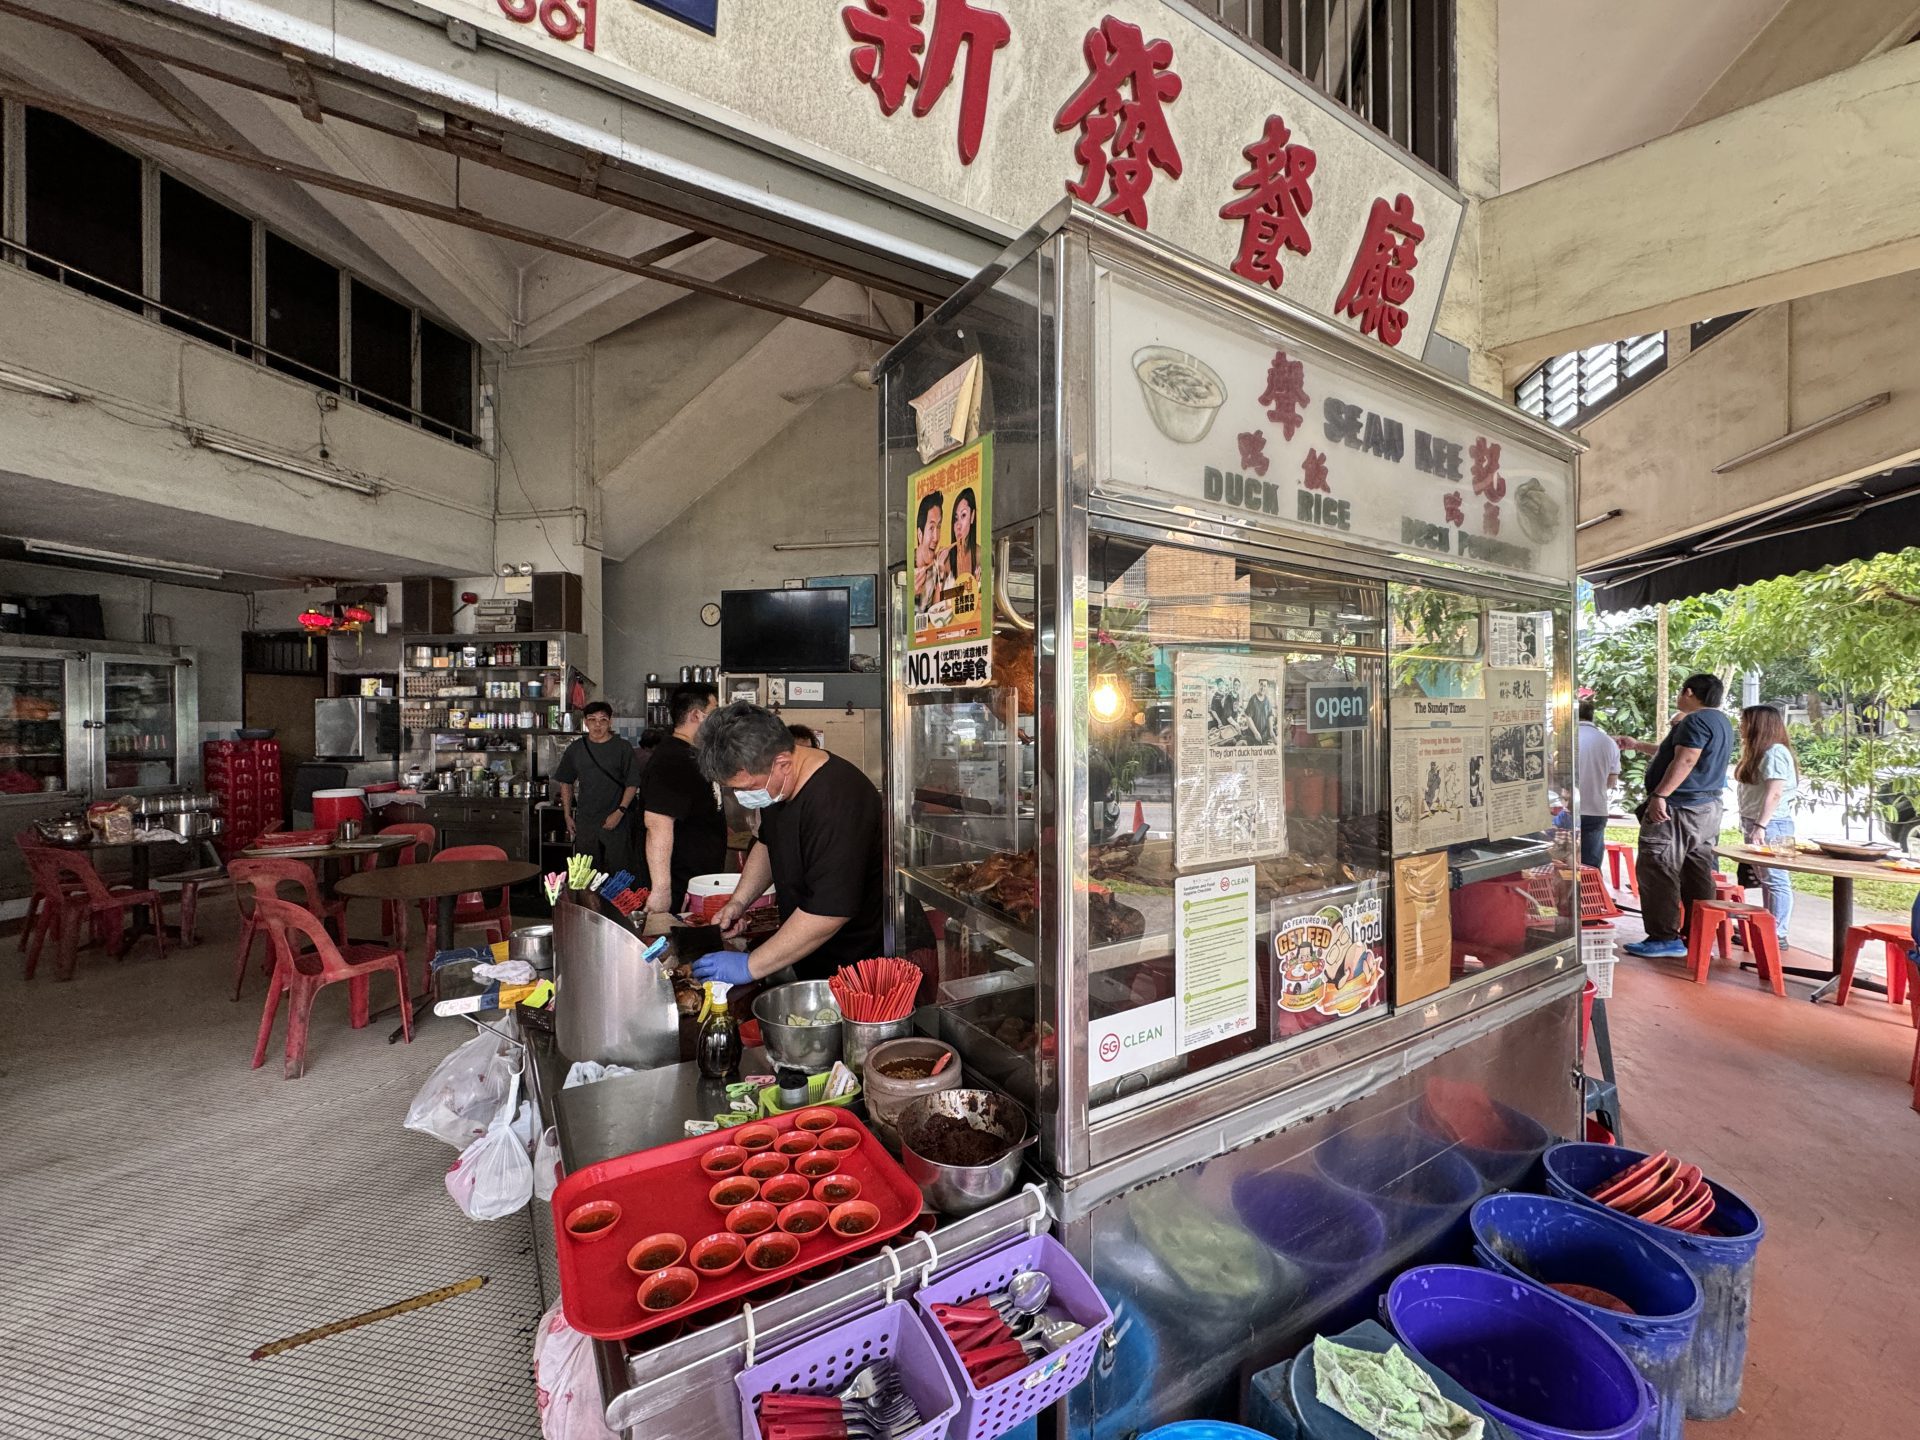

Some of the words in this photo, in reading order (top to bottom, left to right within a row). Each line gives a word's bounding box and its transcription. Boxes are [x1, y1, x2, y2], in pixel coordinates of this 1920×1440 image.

[1323, 397, 1405, 464] SEAN
[1415, 429, 1464, 482] KEE
[1203, 465, 1280, 517] DUCK
[1297, 488, 1351, 531] RICE
[908, 650, 940, 687] NO.1
[1315, 696, 1363, 725] open
[1414, 702, 1427, 714] The
[1428, 702, 1449, 715] Sunday
[1449, 702, 1466, 714] Times
[1209, 748, 1222, 760] They
[1223, 748, 1237, 758] don't
[1238, 747, 1251, 758] duck
[1251, 747, 1263, 757] hard
[1264, 748, 1277, 756] work
[1231, 877, 1249, 887] CLEAN
[1283, 921, 1292, 930] AS
[1292, 916, 1320, 928] FEATURED
[1321, 917, 1328, 926] IN
[1277, 926, 1304, 956] GET
[1306, 926, 1332, 949] FED
[1123, 1026, 1163, 1049] CLEAN
